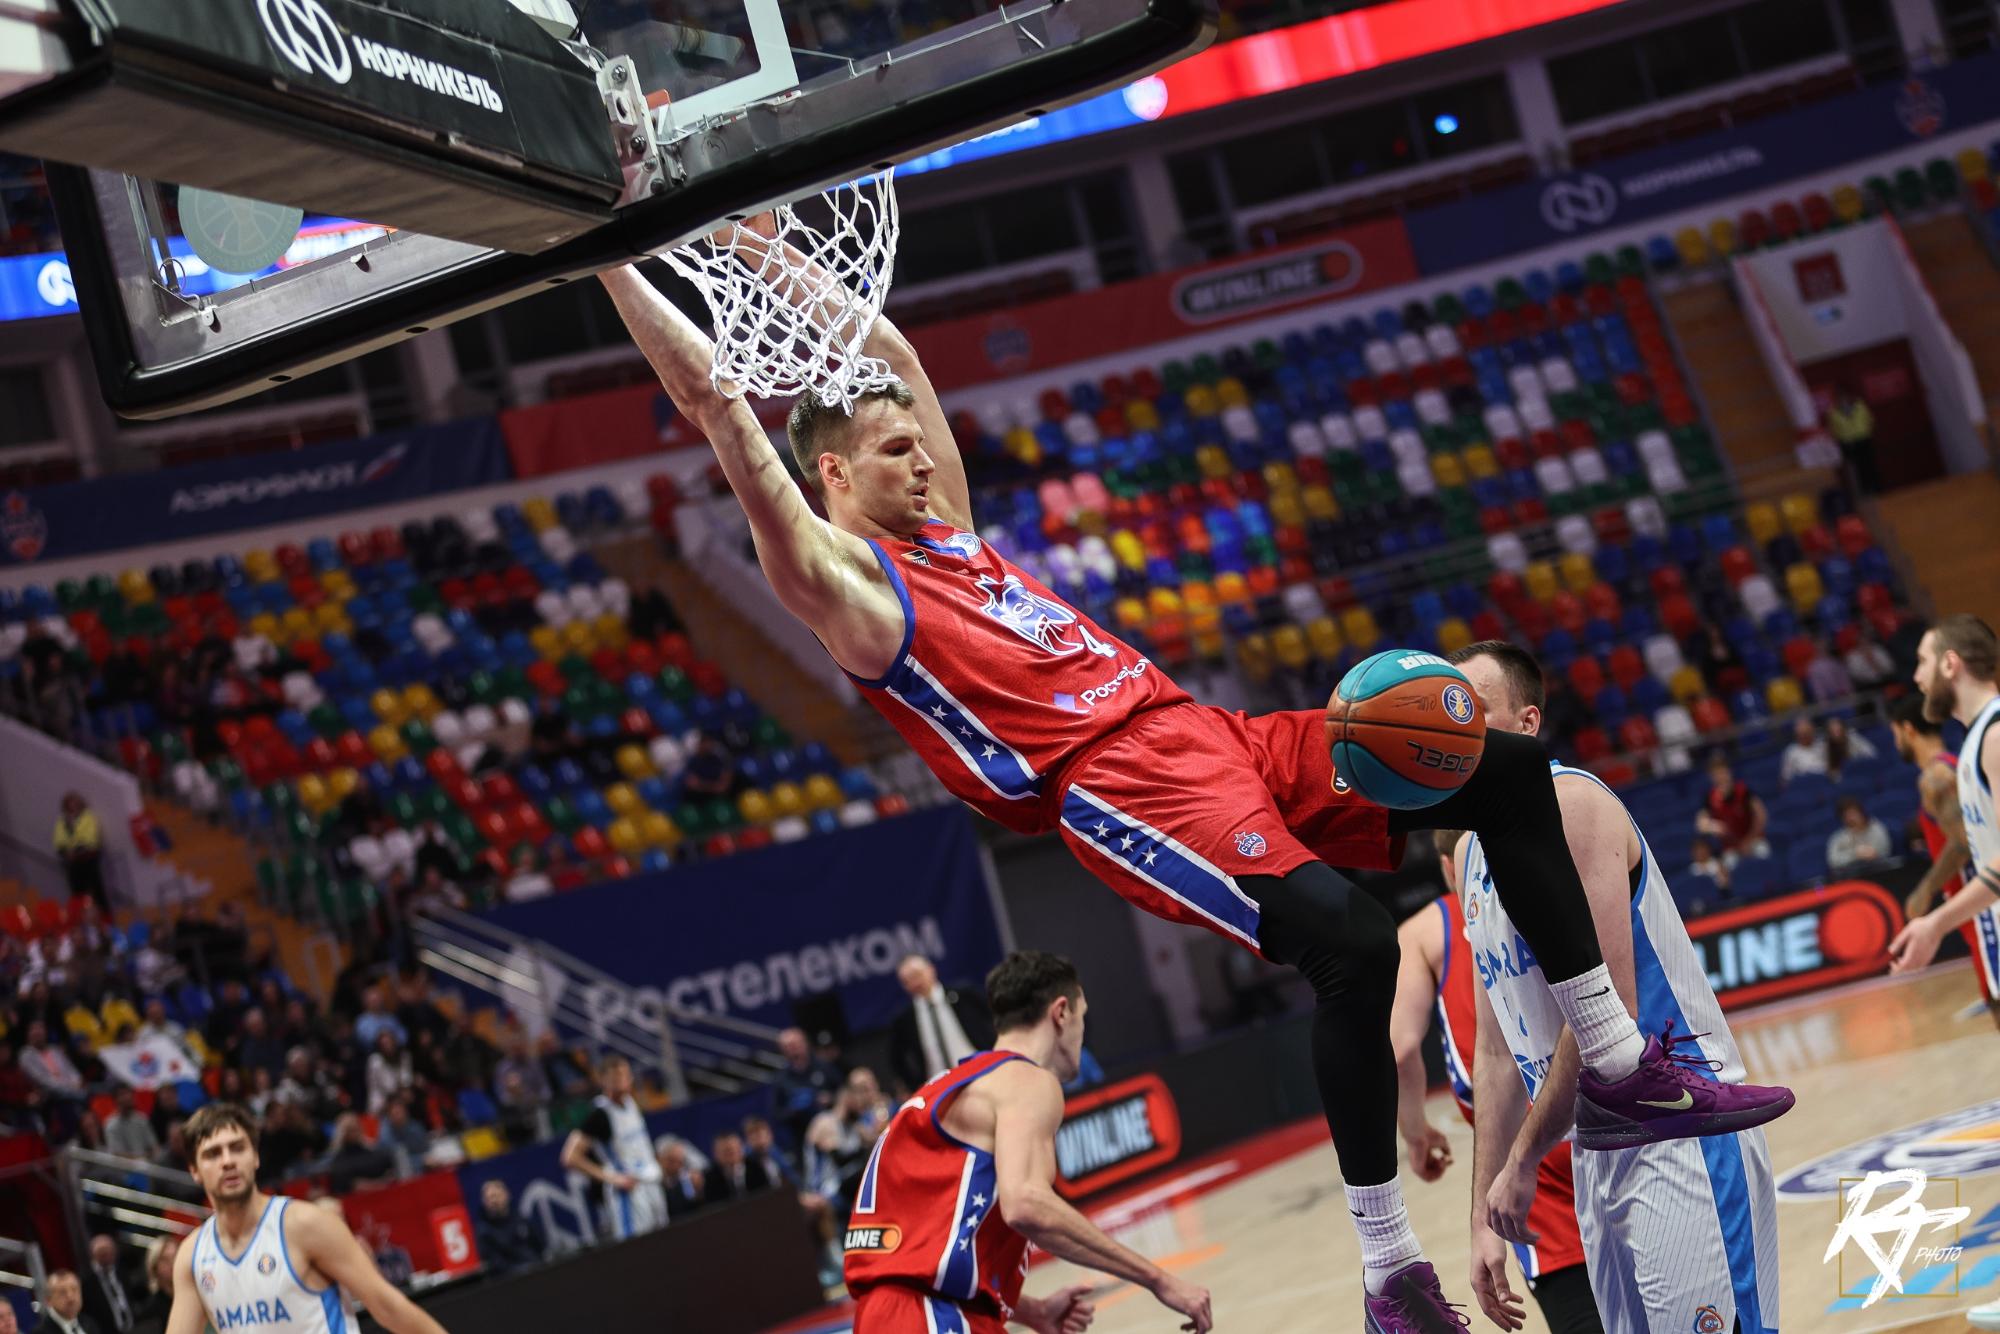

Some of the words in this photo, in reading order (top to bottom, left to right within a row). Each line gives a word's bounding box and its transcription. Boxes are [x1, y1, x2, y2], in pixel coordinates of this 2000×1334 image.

[352, 35, 503, 113] НОРНИКЕЛЬ
[1078, 624, 1117, 658] 4
[1407, 740, 1476, 777] ÖGEL
[1693, 912, 1824, 990] LINE
[441, 1219, 471, 1263] 5
[845, 1230, 880, 1250] LINE
[216, 1297, 291, 1330] AMARA
